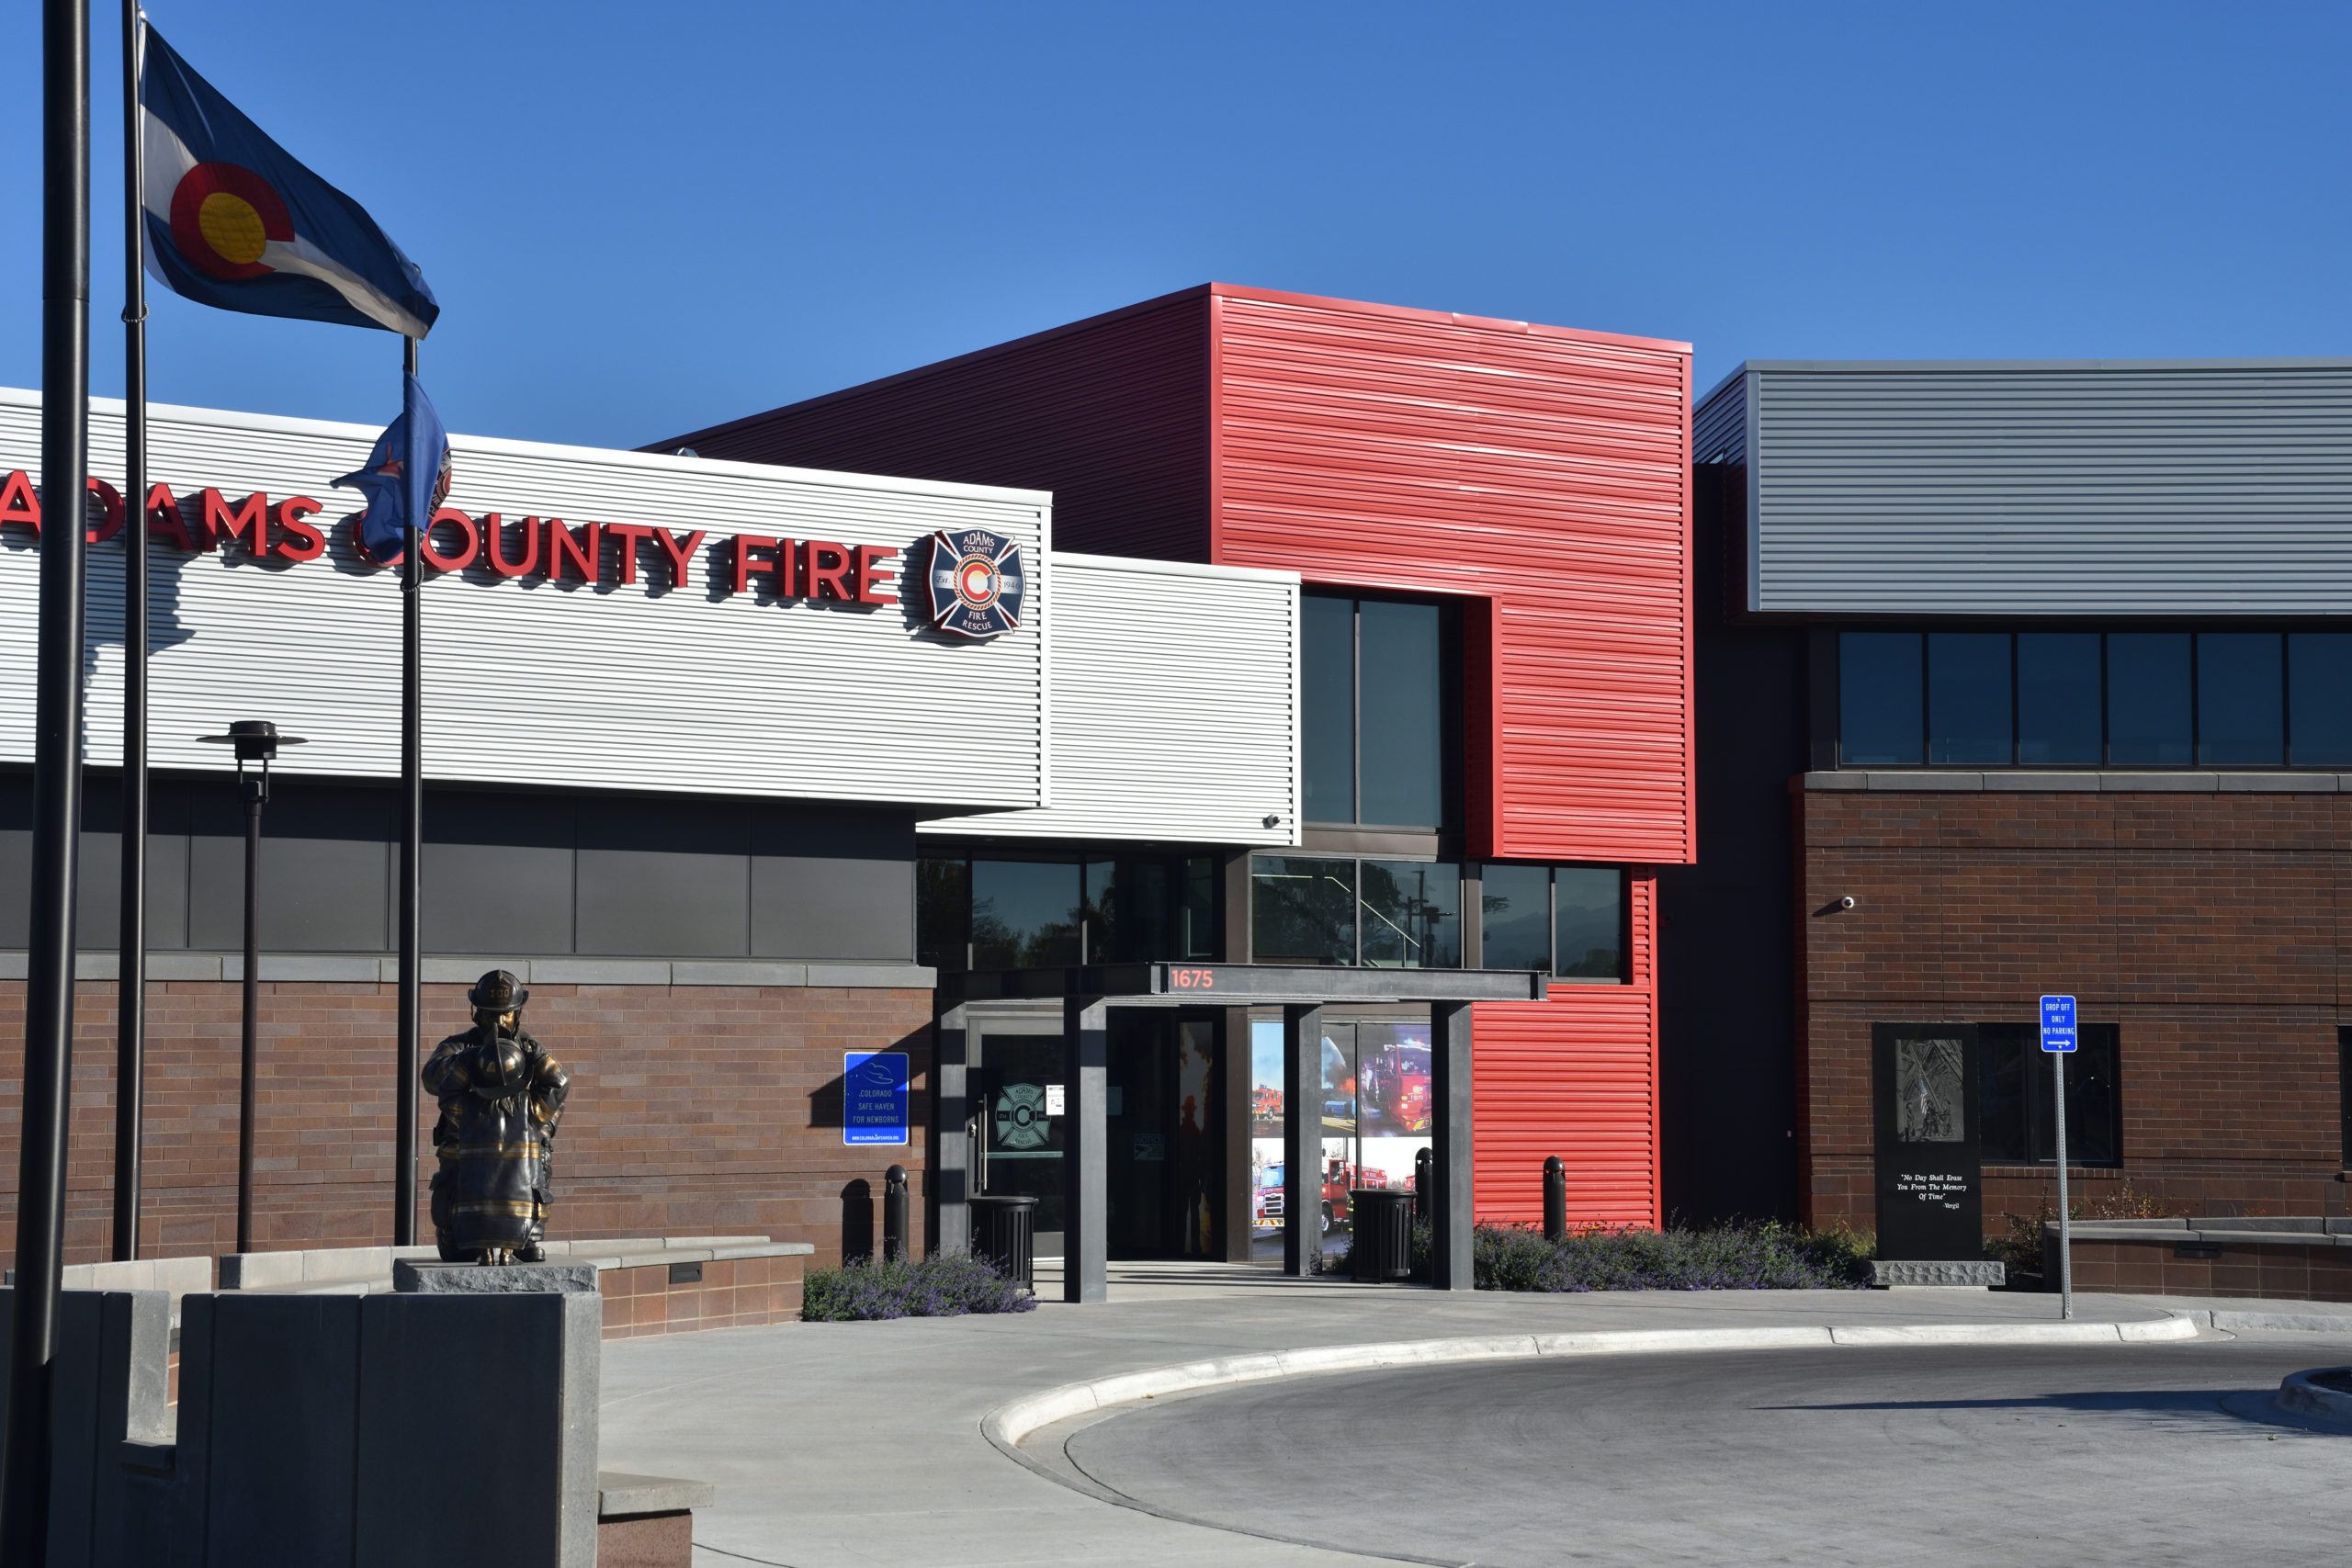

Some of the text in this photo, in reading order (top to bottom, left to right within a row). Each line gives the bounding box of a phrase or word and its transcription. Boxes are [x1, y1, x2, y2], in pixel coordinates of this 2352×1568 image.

[963, 531, 995, 547] ADAMS
[963, 546, 994, 554] COUNTY
[352, 507, 707, 589] OUNTY
[731, 533, 899, 604] FIRE
[968, 611, 988, 620] FIRE
[962, 620, 993, 631] RESCUE
[1171, 969, 1213, 987] 1675
[2045, 1003, 2071, 1011] DROP OFF
[2051, 1015, 2065, 1023] ONLY
[2042, 1027, 2075, 1035] NO PARKING
[860, 1089, 892, 1098] COLORADO
[858, 1102, 895, 1111] SAFE HAVEN
[853, 1115, 899, 1123] FOR NEWBORNS
[1915, 1174, 1928, 1182] Day
[1942, 1183, 1967, 1192] Memory
[1918, 1193, 1927, 1201] Of
